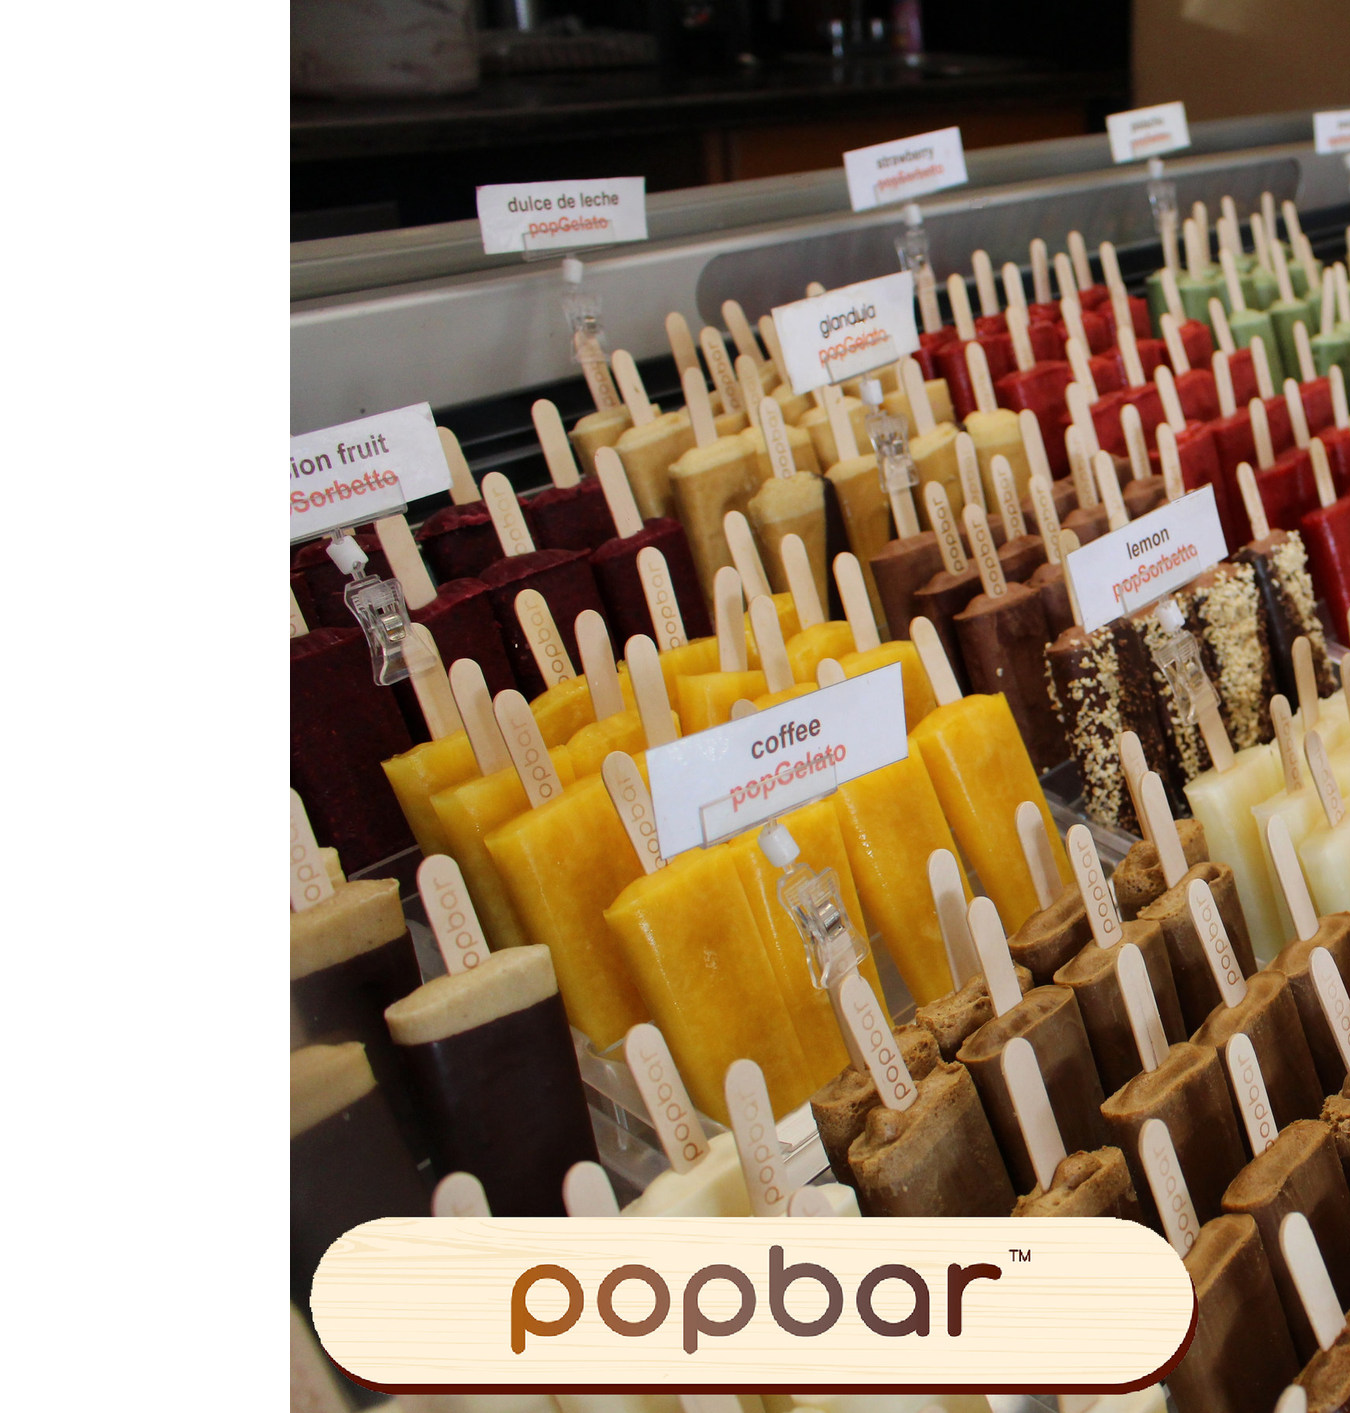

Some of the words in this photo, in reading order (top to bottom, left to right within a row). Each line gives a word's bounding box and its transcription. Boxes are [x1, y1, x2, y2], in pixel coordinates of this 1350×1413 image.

[508, 196, 552, 212] dulce
[557, 193, 576, 209] de
[581, 191, 619, 207] leche
[529, 216, 609, 238] popGelato
[819, 328, 888, 368] popGelato
[290, 453, 332, 480] ion
[337, 434, 390, 465] fruit
[492, 487, 527, 555] opbar
[1126, 527, 1170, 560] lemon
[1112, 544, 1198, 603] popSorbetto
[510, 718, 553, 798] opbar
[751, 718, 821, 759] coffee
[730, 744, 847, 812] popGelato
[1077, 841, 1116, 934] popbar
[433, 877, 480, 969] opbar
[1196, 896, 1240, 986] popbar
[853, 1001, 910, 1100] popbar
[639, 1050, 703, 1162] popbar
[741, 1089, 784, 1206] popbar
